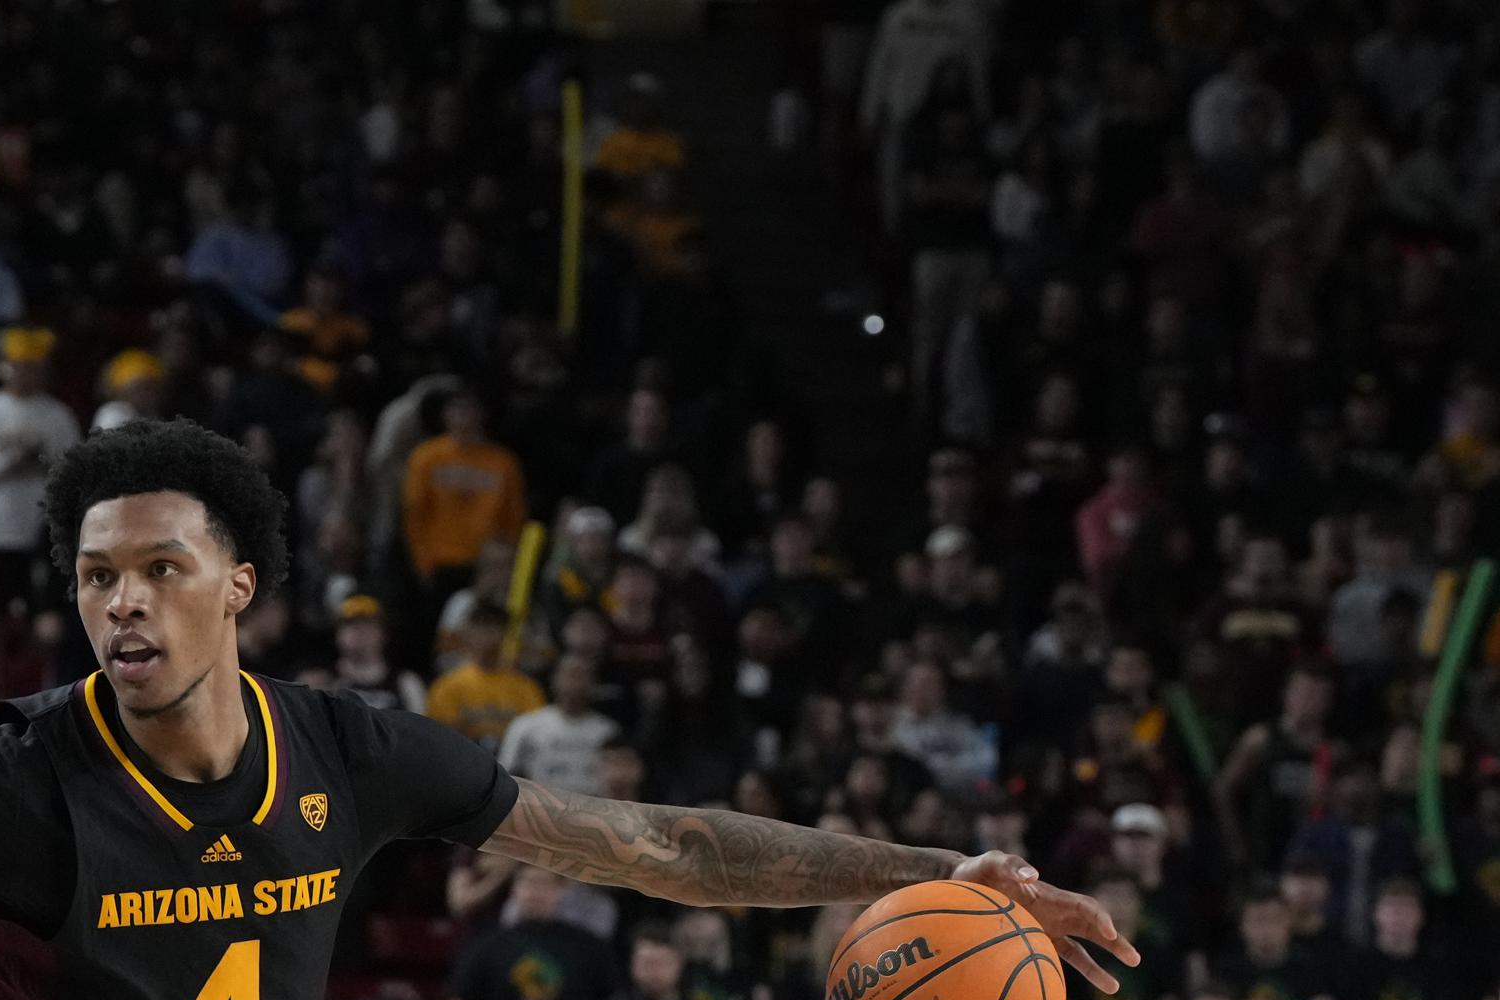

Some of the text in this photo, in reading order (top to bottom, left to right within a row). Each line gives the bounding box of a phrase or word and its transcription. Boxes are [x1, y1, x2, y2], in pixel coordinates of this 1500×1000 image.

[302, 796, 325, 818] PAC
[309, 810, 323, 825] 12
[201, 850, 243, 863] adidas
[97, 868, 341, 929] ARIZONA STATE
